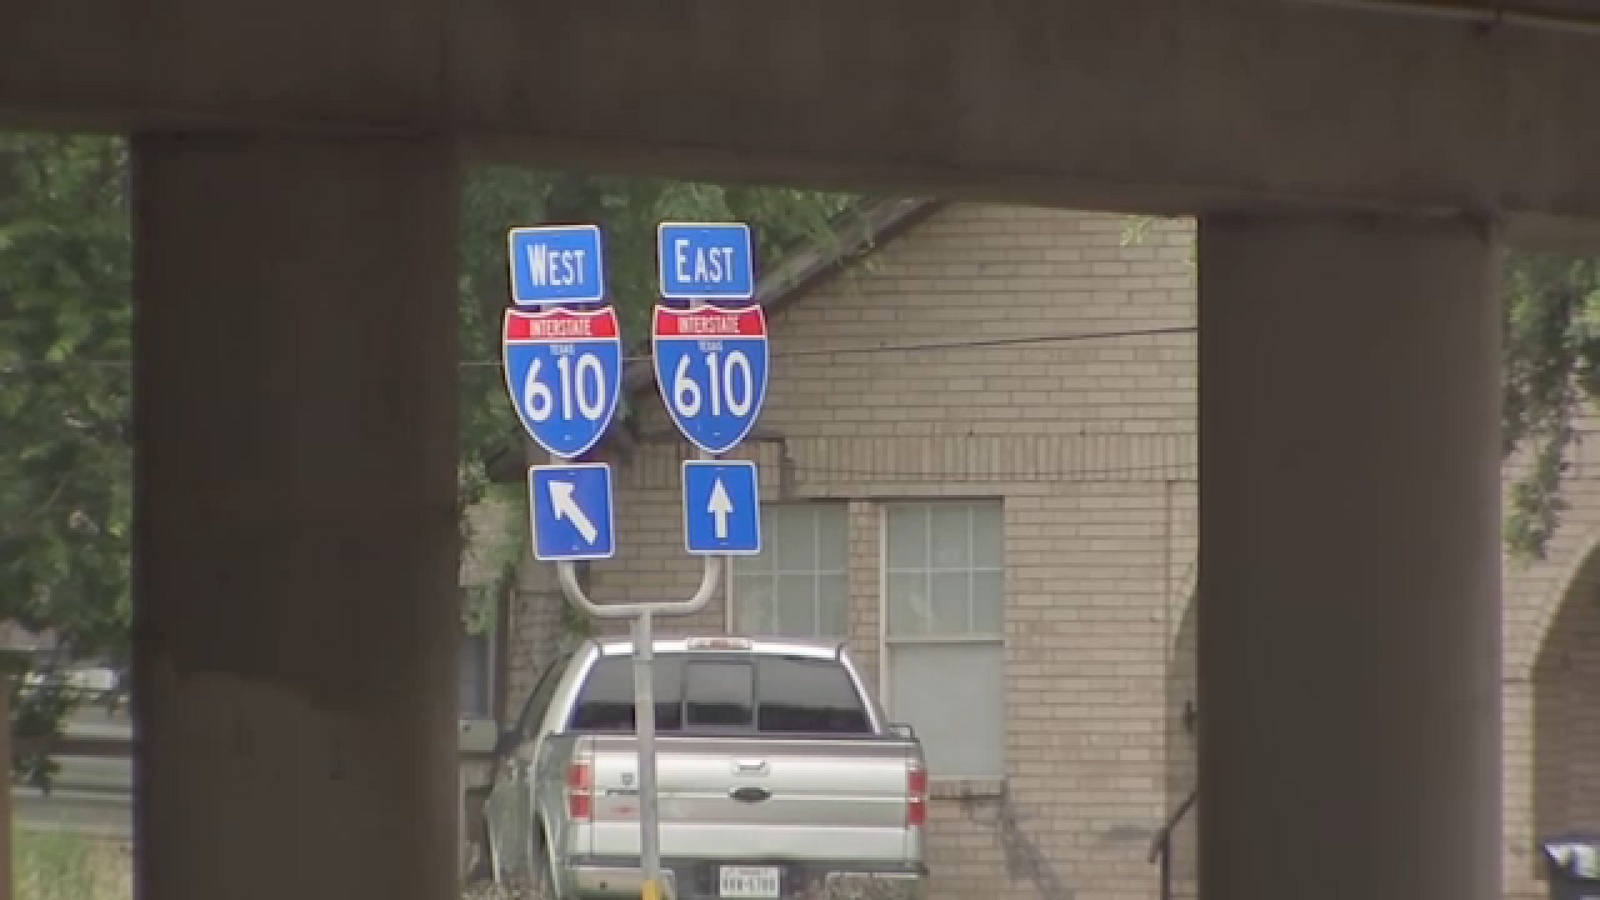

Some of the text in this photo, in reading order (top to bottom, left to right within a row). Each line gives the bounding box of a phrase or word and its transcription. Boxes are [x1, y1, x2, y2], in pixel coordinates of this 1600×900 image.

[526, 243, 586, 287] WEST
[674, 239, 735, 283] EAST
[529, 318, 592, 336] INTERSTATE
[679, 314, 741, 334] INTERSTATE
[523, 355, 606, 421] 610
[673, 350, 753, 418] 610
